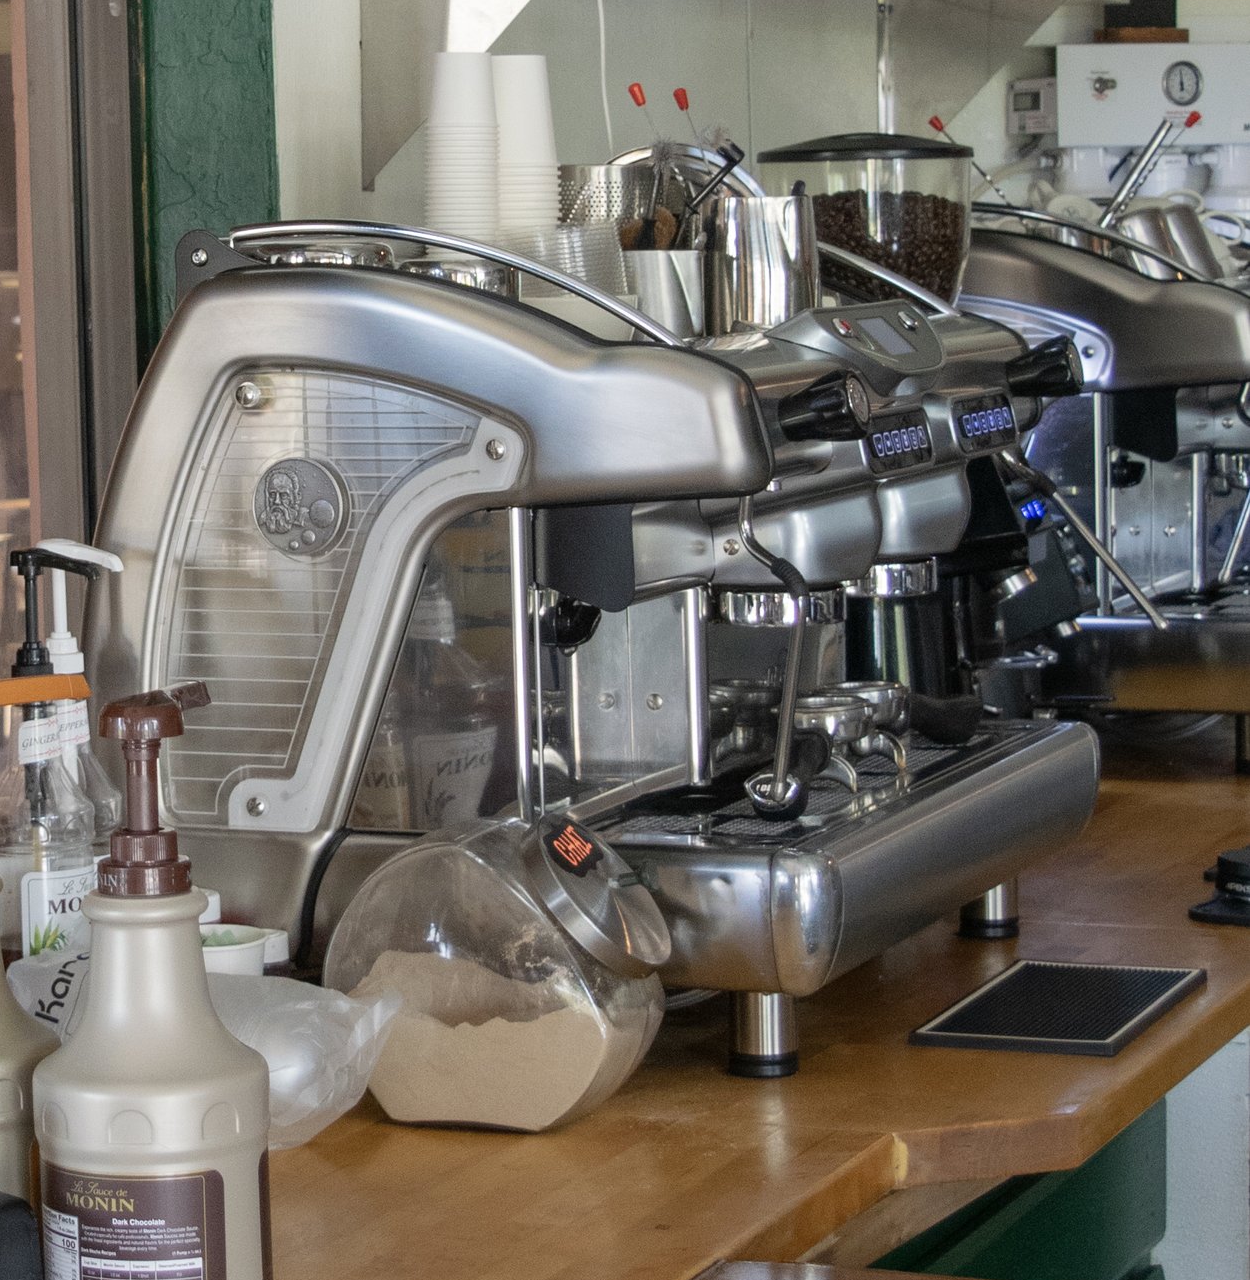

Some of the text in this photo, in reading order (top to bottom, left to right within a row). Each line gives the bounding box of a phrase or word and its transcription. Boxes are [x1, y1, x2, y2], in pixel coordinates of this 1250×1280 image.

[553, 824, 593, 867] CHAI
[66, 1192, 135, 1213] MONIN
[112, 1218, 166, 1226] Dark Chocolate
